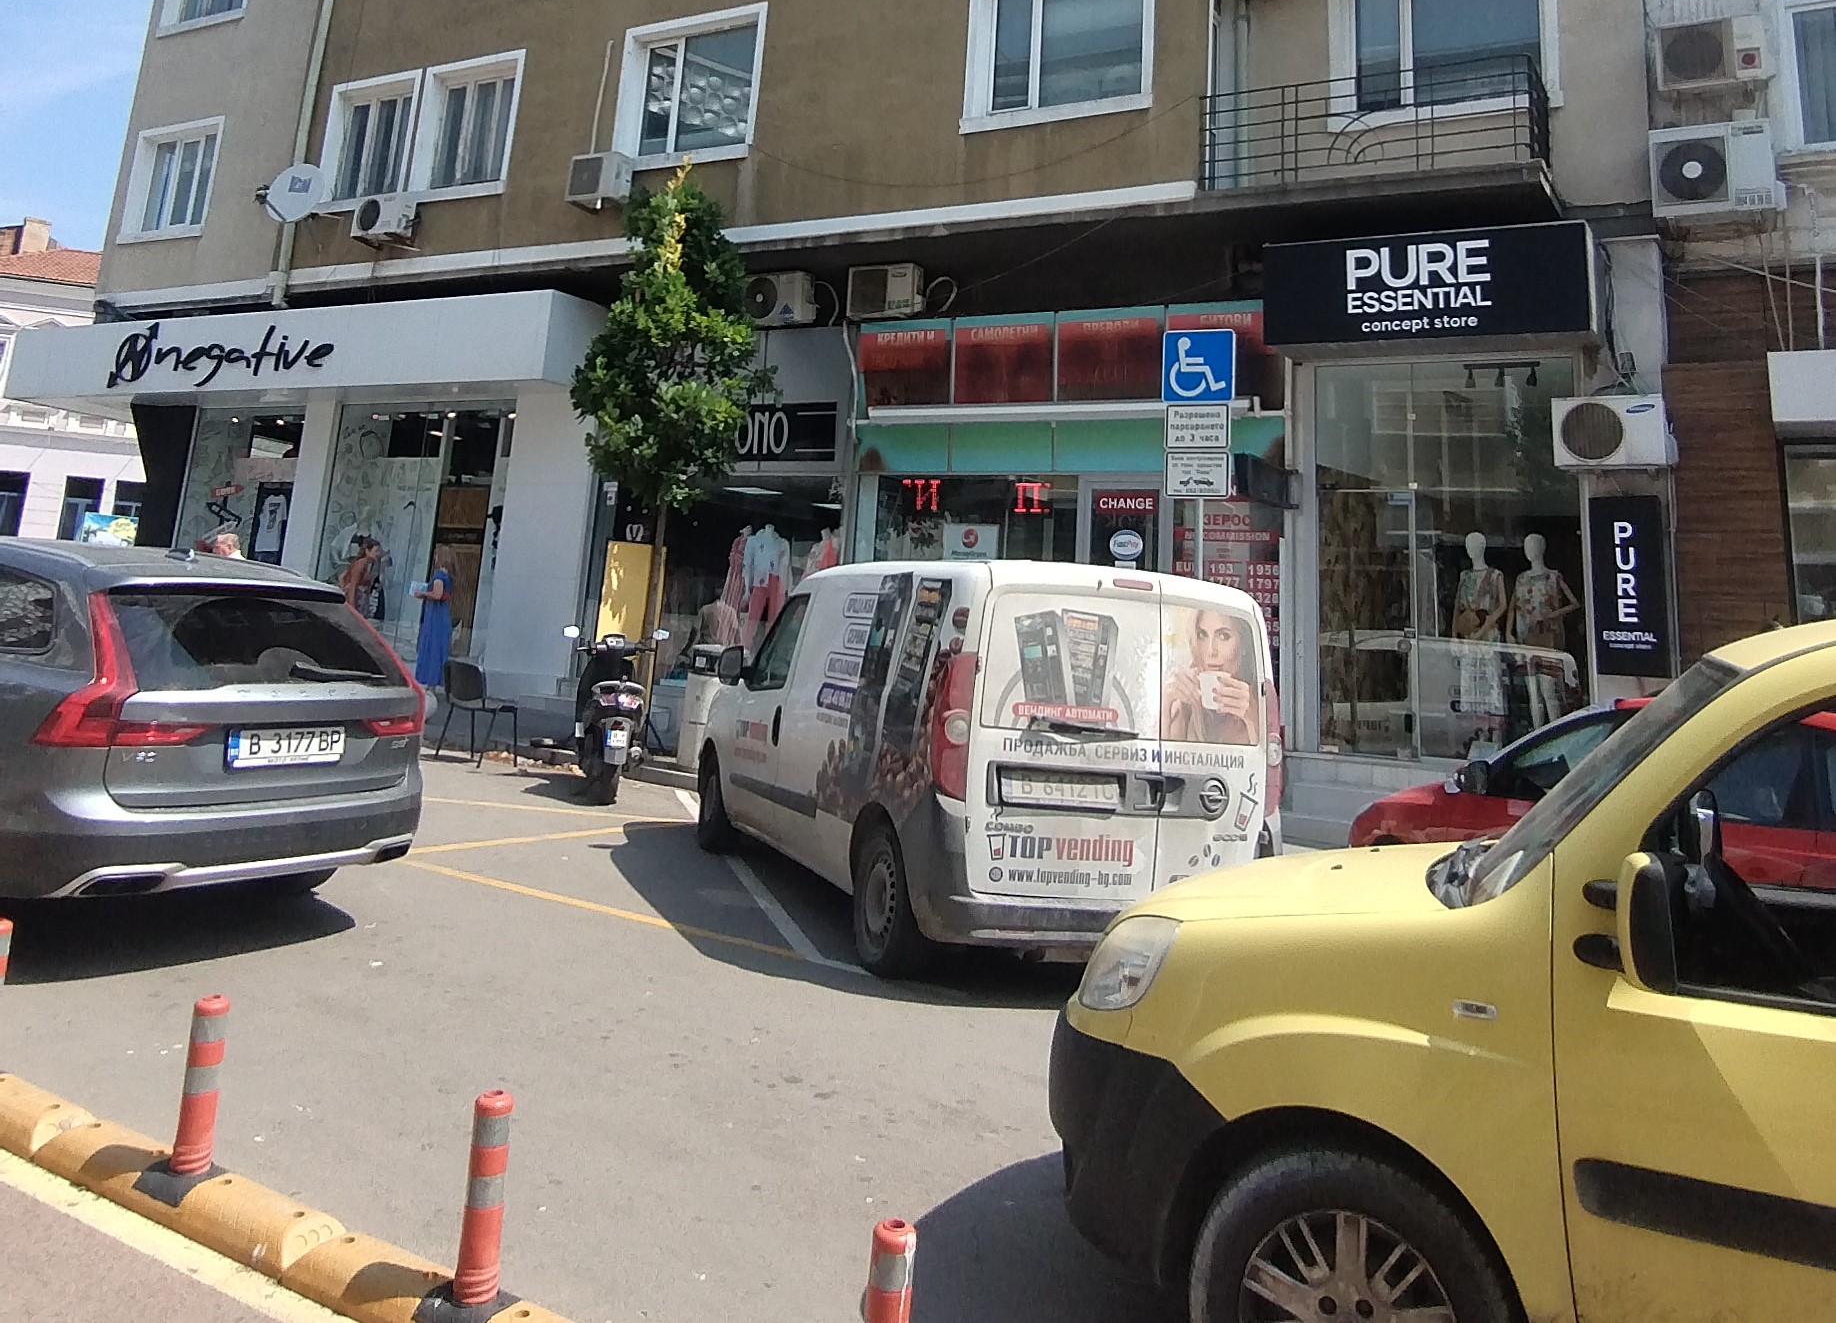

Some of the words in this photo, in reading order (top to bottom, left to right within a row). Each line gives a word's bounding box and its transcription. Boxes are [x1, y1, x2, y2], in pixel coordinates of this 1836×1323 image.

[1345, 239, 1491, 290] PURE
[1347, 285, 1492, 314] ESSENTIAL
[1361, 316, 1430, 333] concept
[1434, 315, 1478, 328] store
[877, 330, 925, 345] КРЕДИТИ
[970, 325, 1039, 342] САМОЛЕТНИ
[154, 325, 335, 387] negative
[1174, 435, 1186, 443] до
[1189, 433, 1196, 443] 3
[1199, 434, 1220, 442] часа
[1099, 497, 1154, 510] CHANGE
[1203, 531, 1271, 541] COMMISSION
[1176, 561, 1194, 573] EU
[1613, 521, 1639, 623] PURE
[1603, 630, 1657, 642] ESSENTIAL
[1018, 704, 1063, 717] ВЕНДИНГ
[1065, 709, 1113, 720] АВТОМАТИ
[249, 733, 261, 755] B
[271, 731, 316, 754] 3177
[1095, 744, 1147, 763] СЕРВИЗ
[1151, 748, 1161, 763] И
[1164, 750, 1244, 771] ИНСТАЛАЦИЯ
[984, 821, 1034, 834] COMBO
[1008, 833, 1053, 860] TOP
[1056, 833, 1134, 868] vending
[1008, 867, 1132, 888] www.topvending-bg.com
